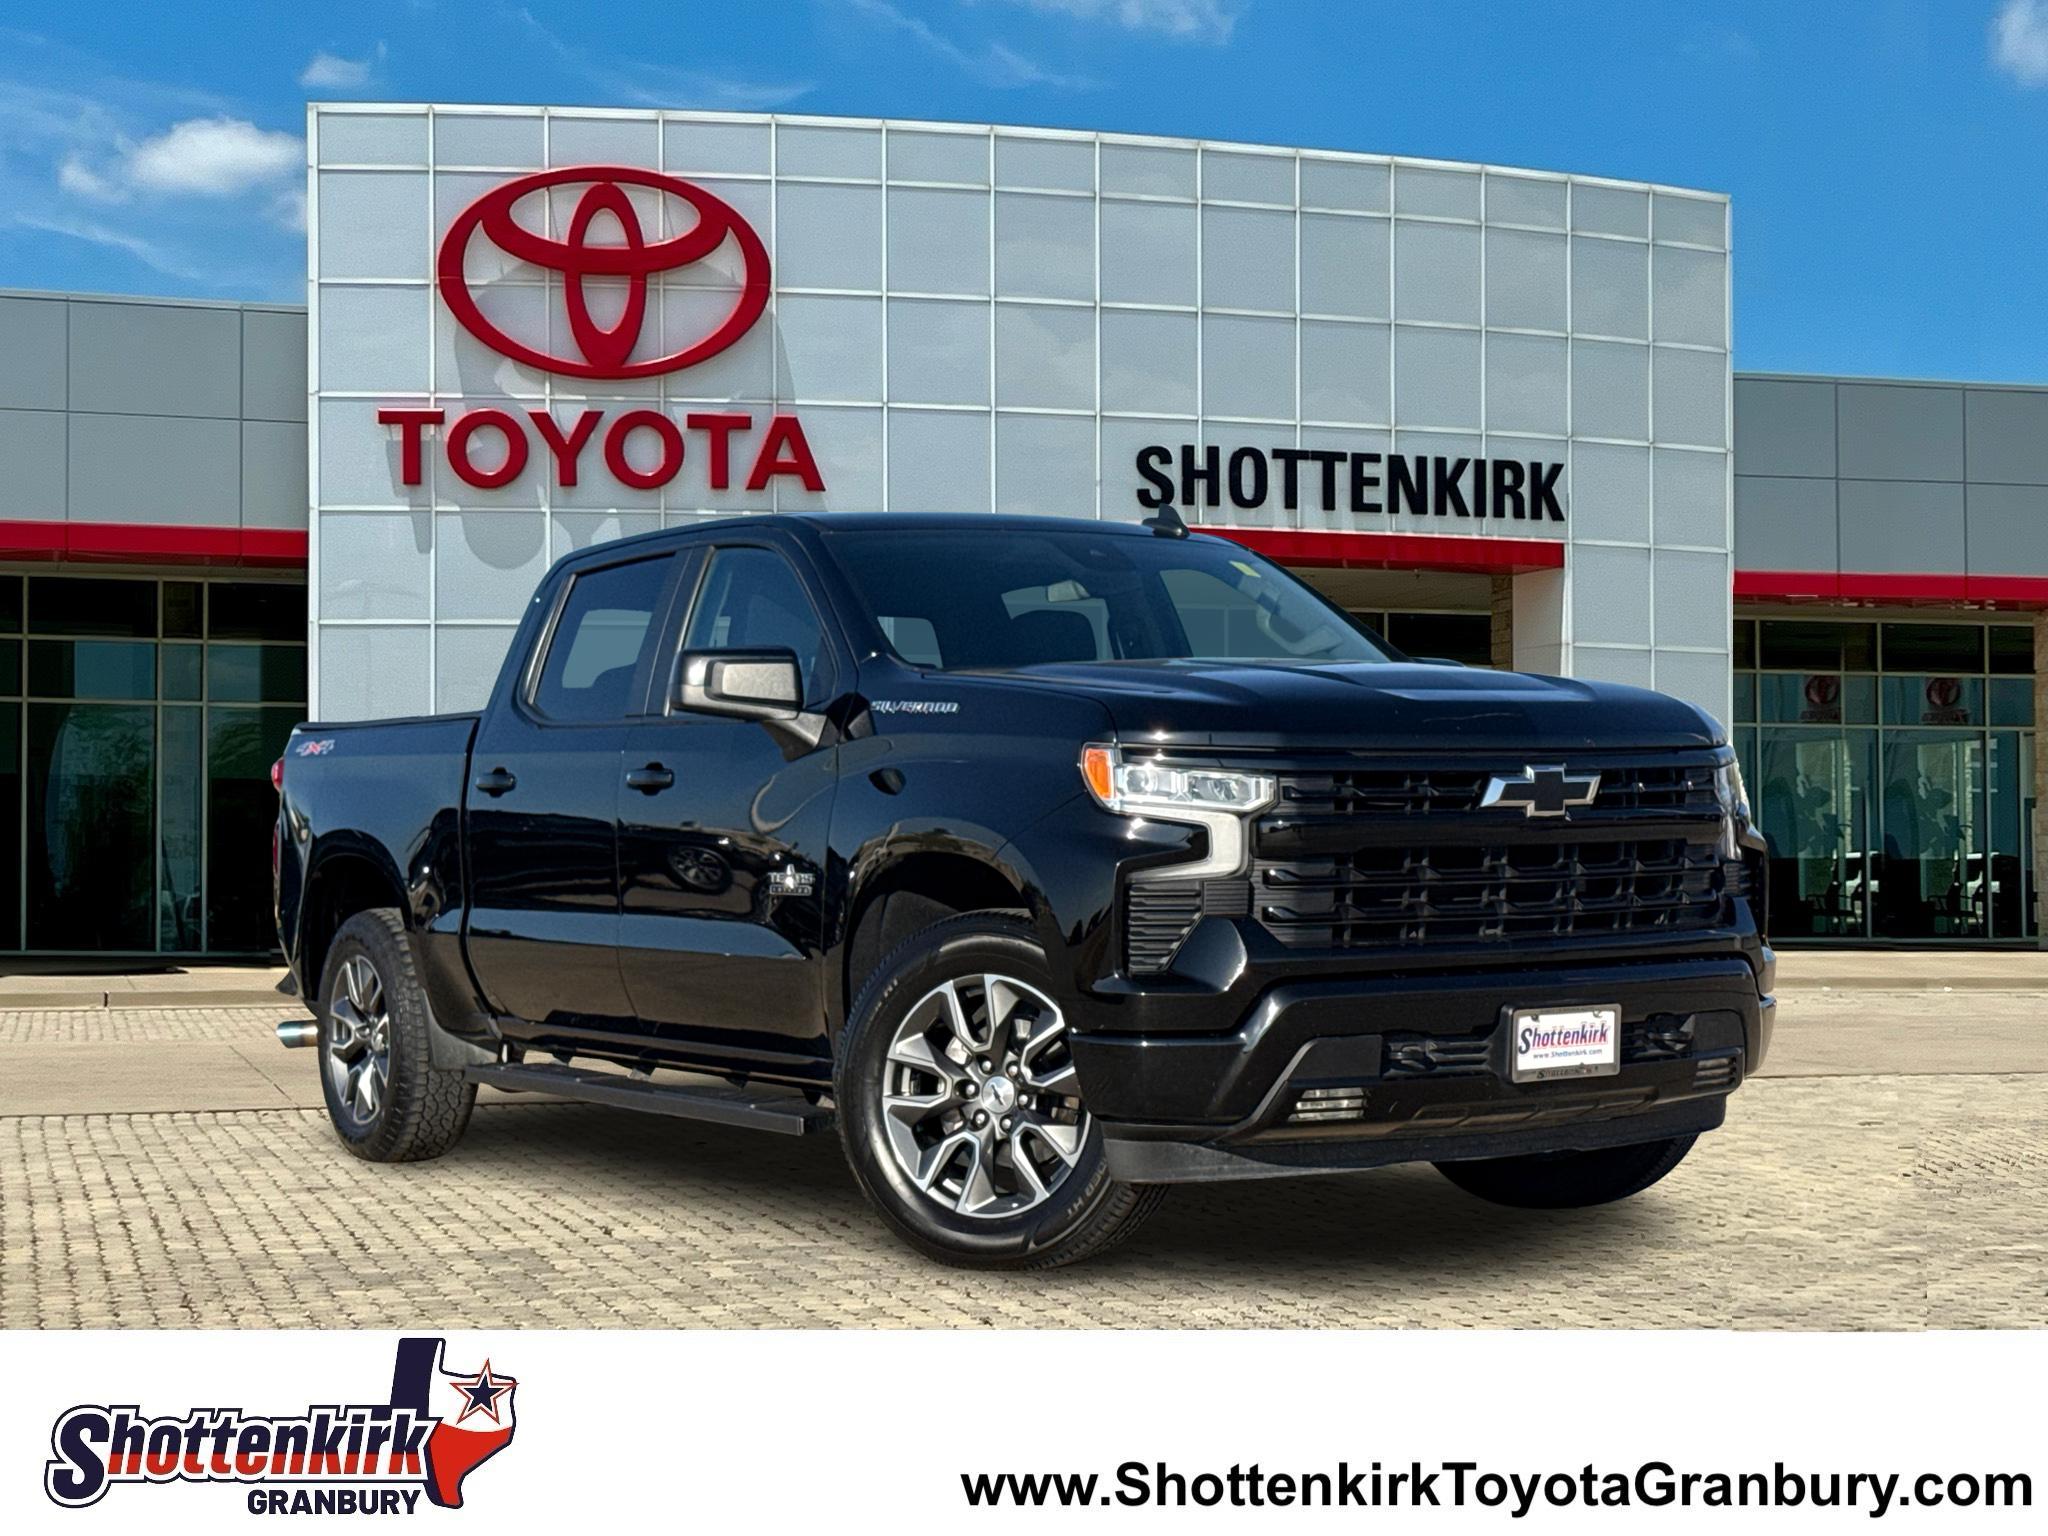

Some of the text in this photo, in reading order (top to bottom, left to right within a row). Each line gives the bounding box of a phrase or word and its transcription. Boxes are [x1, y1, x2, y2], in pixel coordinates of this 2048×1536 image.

[378, 407, 826, 492] TOYOTA
[1136, 445, 1566, 521] SHOTTENKIRK
[1519, 1023, 1609, 1054] Shottenkirk
